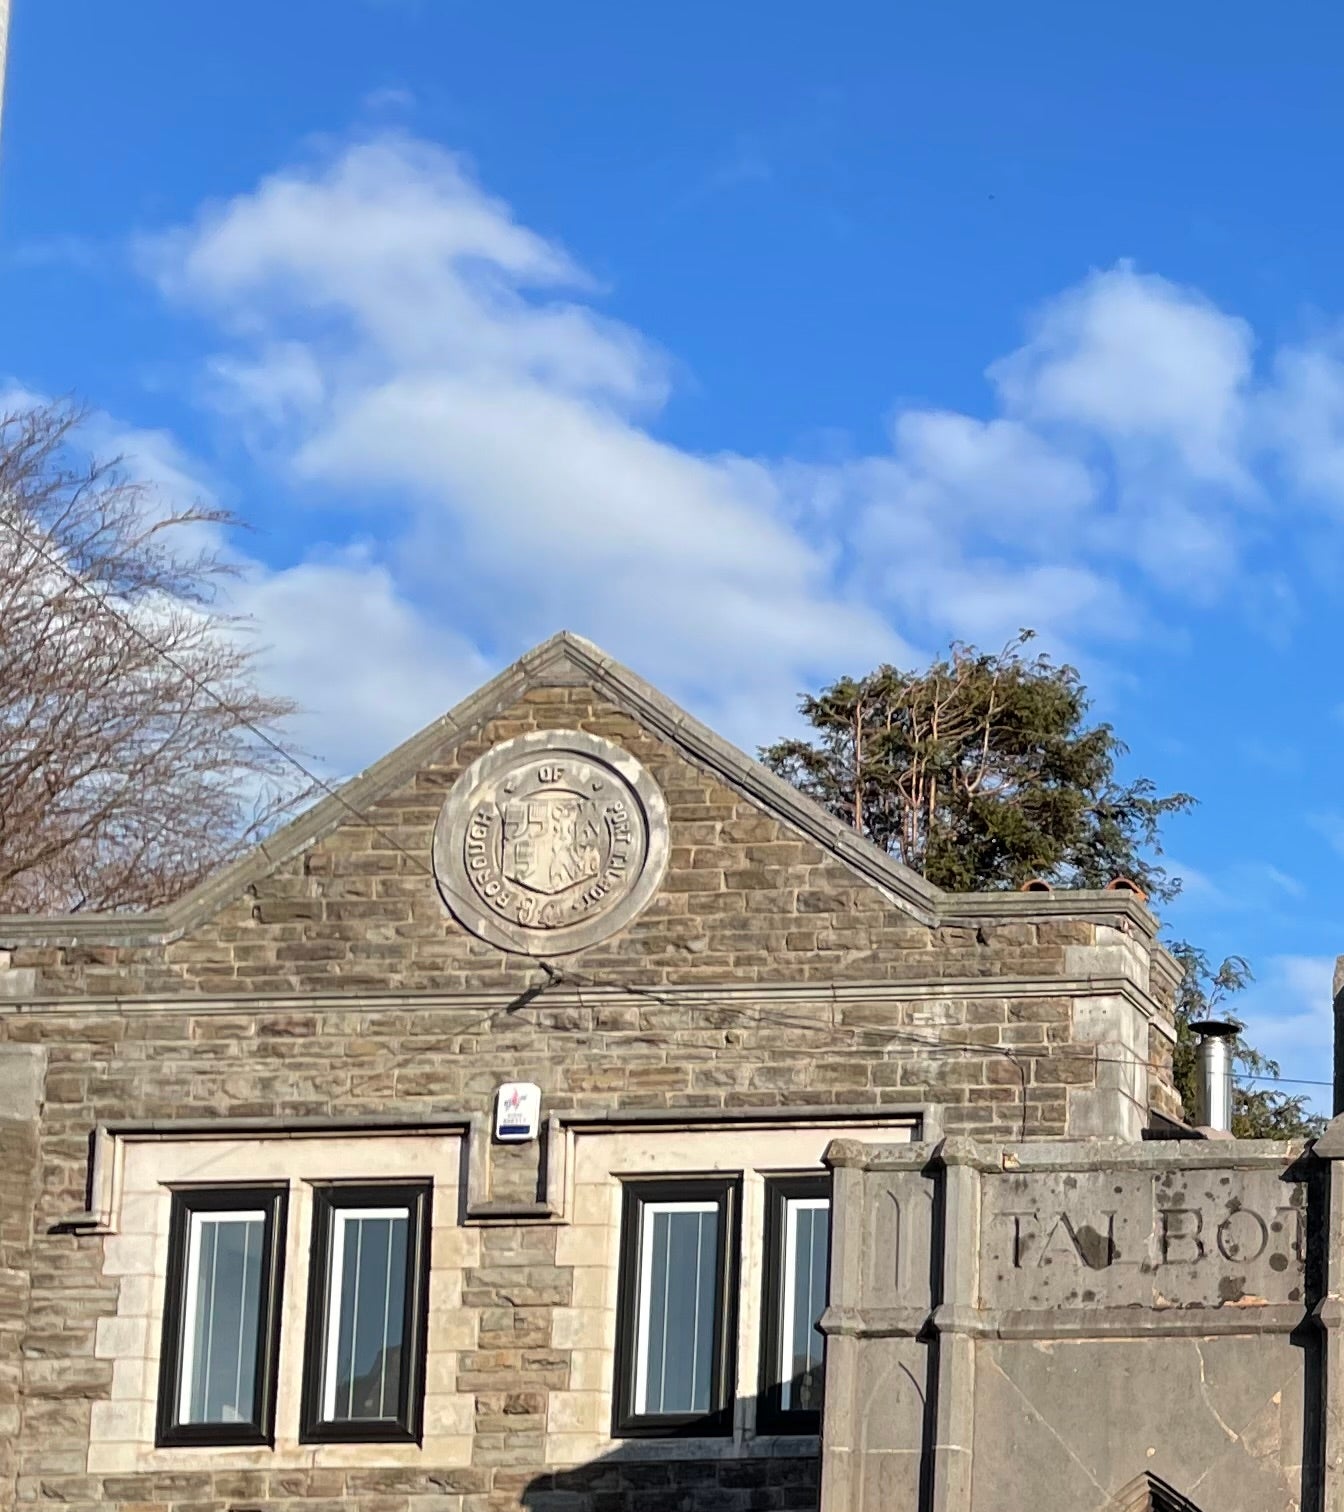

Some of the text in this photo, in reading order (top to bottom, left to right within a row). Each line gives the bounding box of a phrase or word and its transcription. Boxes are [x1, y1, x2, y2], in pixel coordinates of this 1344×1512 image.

[468, 810, 510, 910] BOROUGH
[538, 767, 565, 784] OF
[611, 801, 633, 845] PORT
[991, 1207, 1305, 1268] TALBOT
